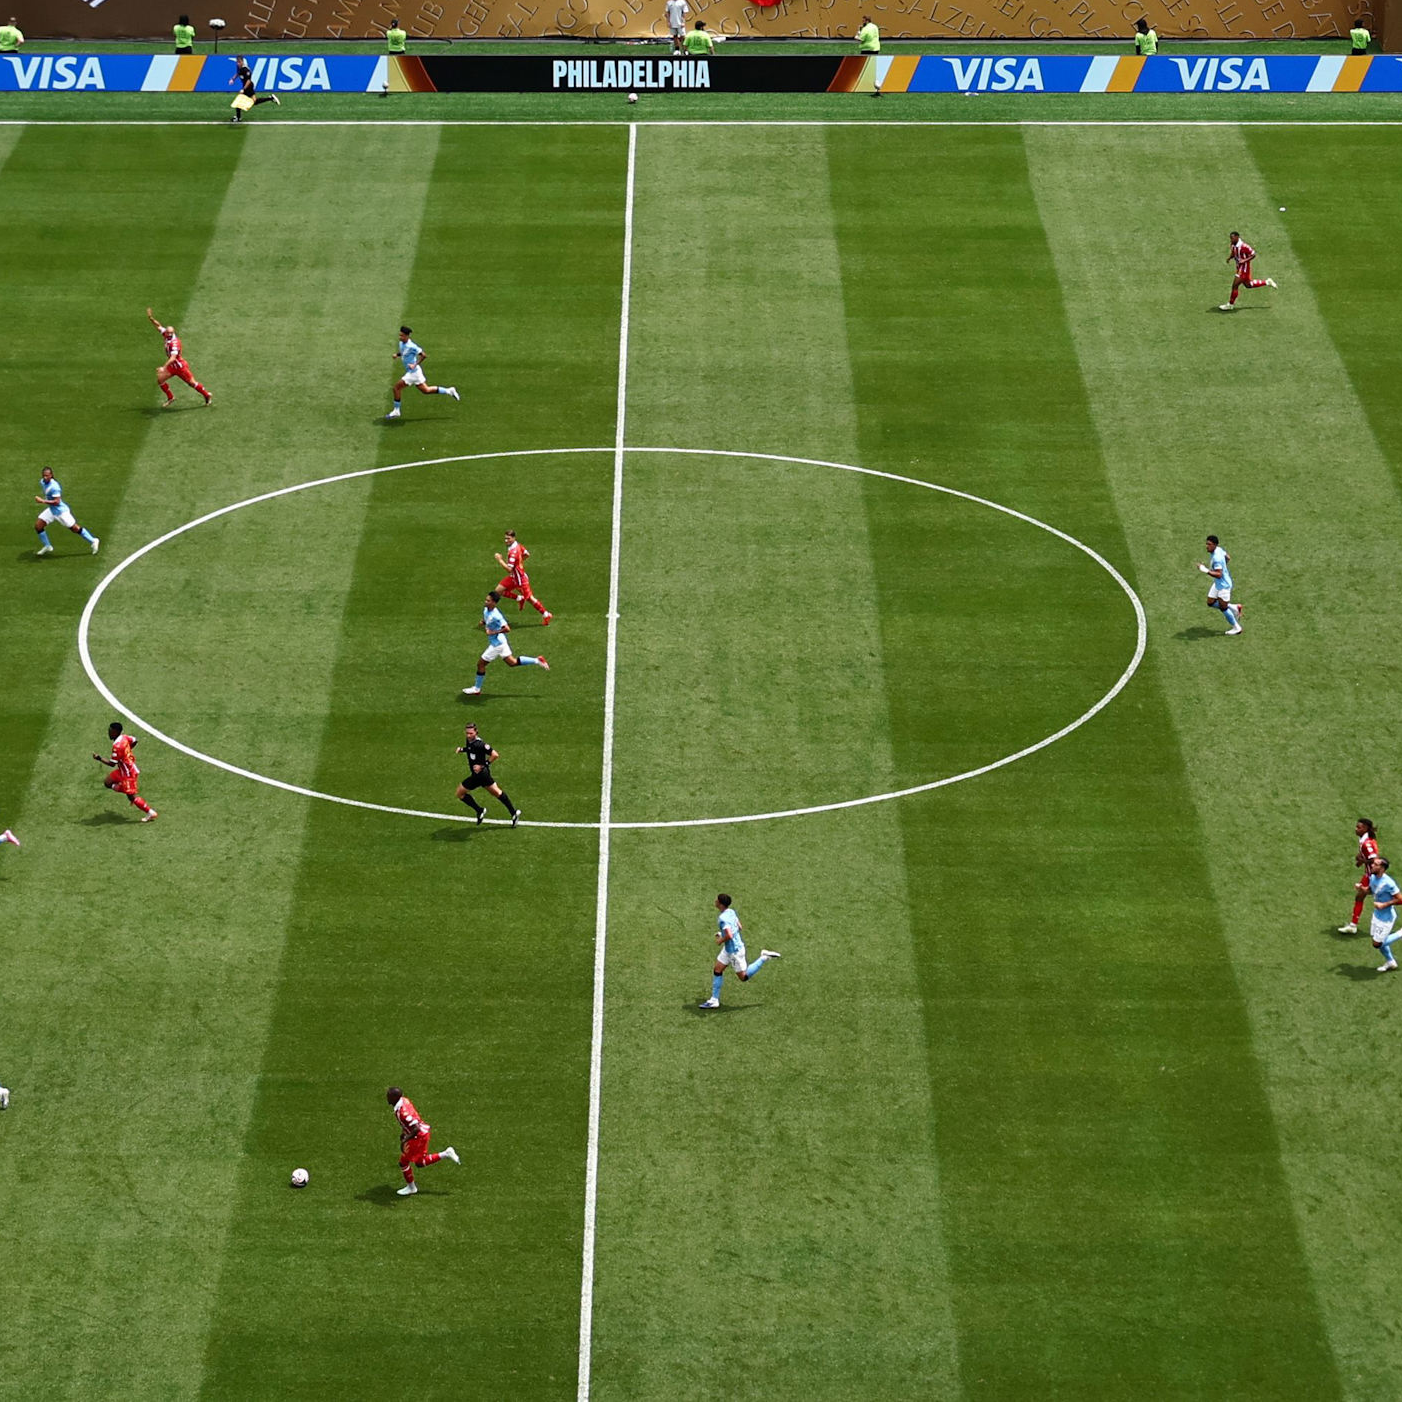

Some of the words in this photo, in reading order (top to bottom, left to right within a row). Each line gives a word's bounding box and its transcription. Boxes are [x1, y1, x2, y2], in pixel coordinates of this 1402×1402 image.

[3, 57, 106, 90] VISA
[552, 60, 711, 88] PHILADELPHIA
[943, 57, 1044, 91] VISA
[1169, 57, 1271, 91] VISA
